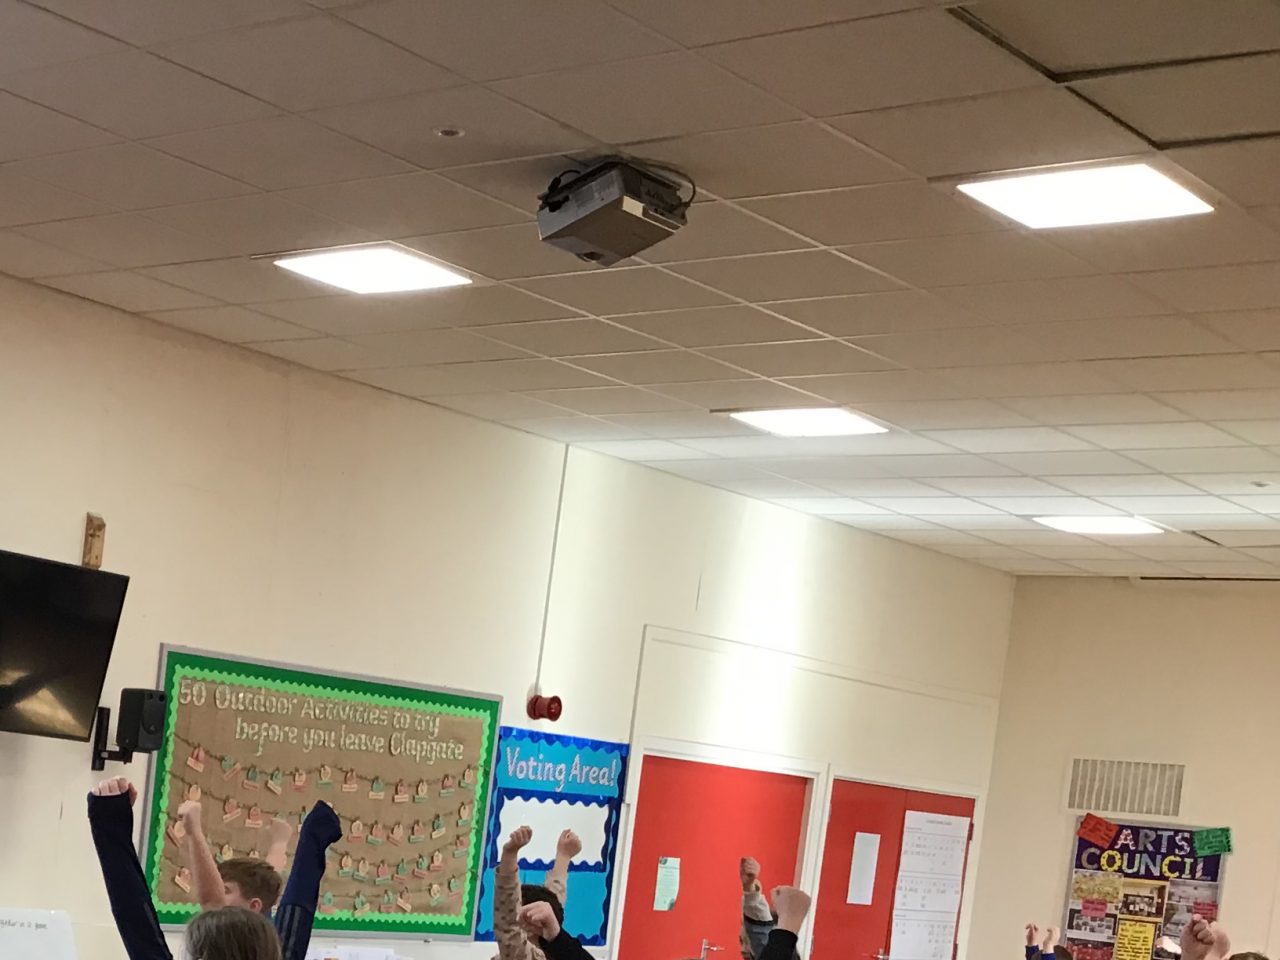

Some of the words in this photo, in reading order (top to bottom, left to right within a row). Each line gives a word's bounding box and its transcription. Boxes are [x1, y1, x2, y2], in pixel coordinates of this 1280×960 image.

[179, 679, 207, 707] 50
[214, 684, 298, 714] Outdoor
[300, 697, 388, 727] Activities
[392, 709, 410, 729] to
[414, 713, 440, 740] try
[235, 717, 298, 757] before
[303, 728, 335, 752] you
[339, 724, 385, 754] leave
[389, 731, 465, 766] Clapgate
[506, 746, 566, 792] Voting
[568, 754, 617, 787] Area!
[1081, 847, 1211, 881] COUNCIL
[1114, 829, 1191, 855] ARTS
